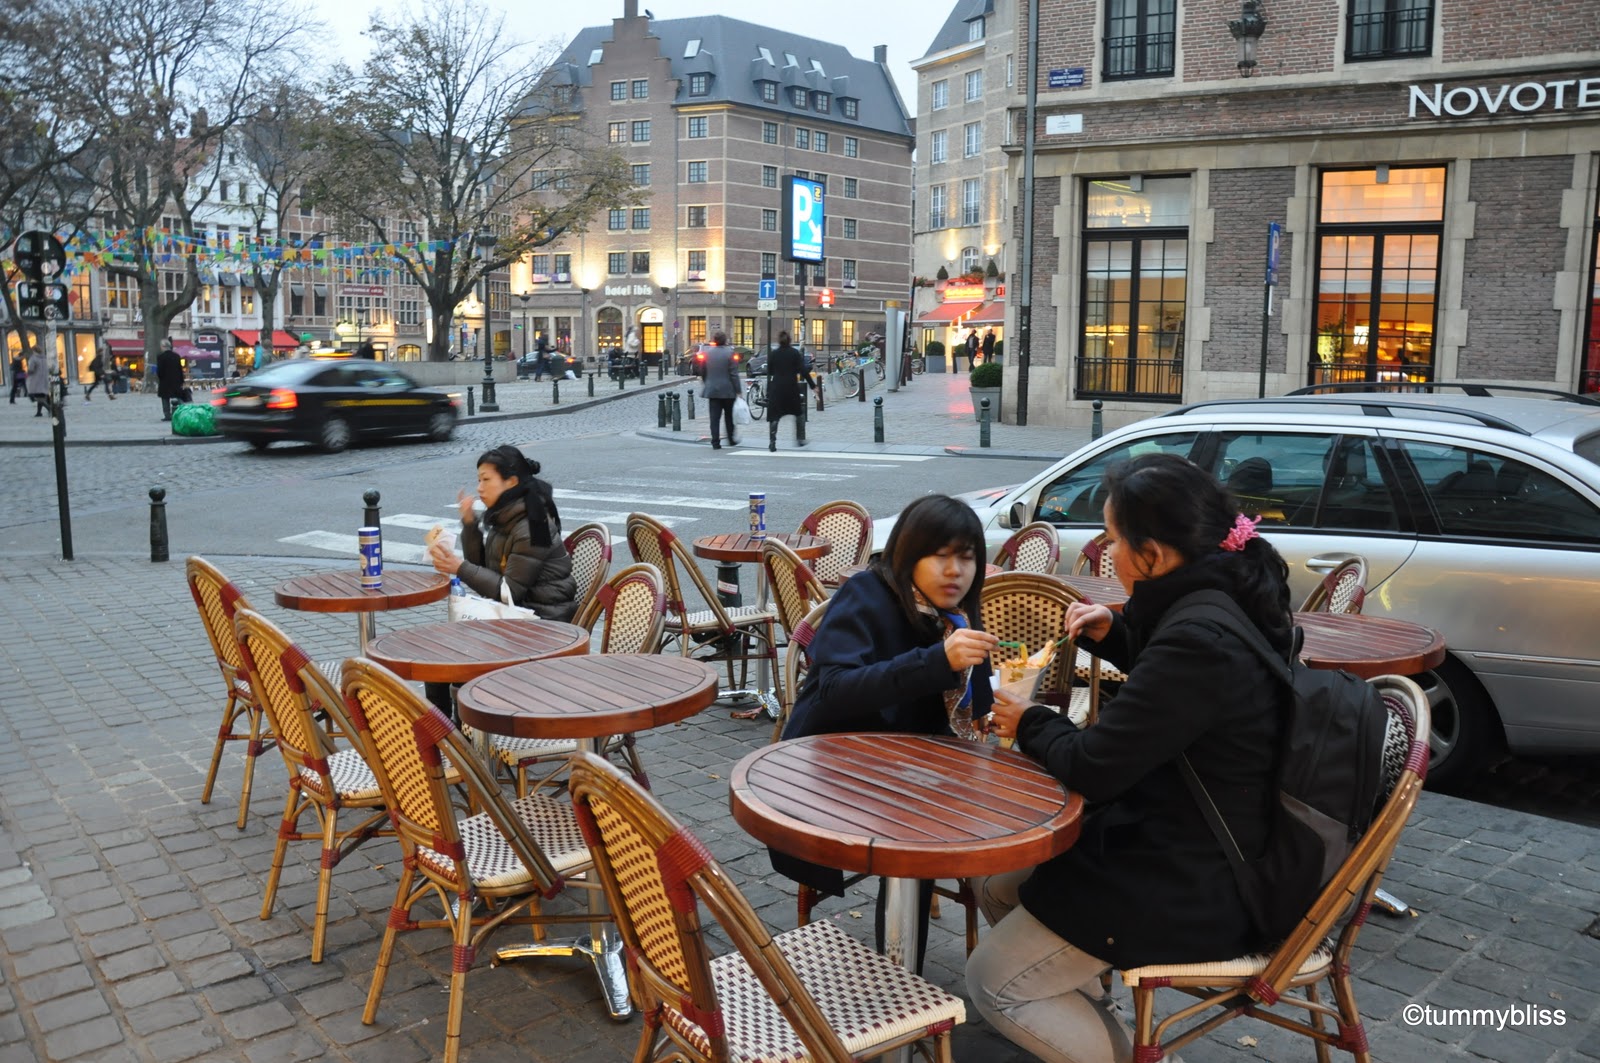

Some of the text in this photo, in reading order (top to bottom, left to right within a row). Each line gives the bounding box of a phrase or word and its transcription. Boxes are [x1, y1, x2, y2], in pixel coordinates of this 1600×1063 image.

[793, 184, 813, 240] P
[605, 284, 653, 296] hotel ibis
